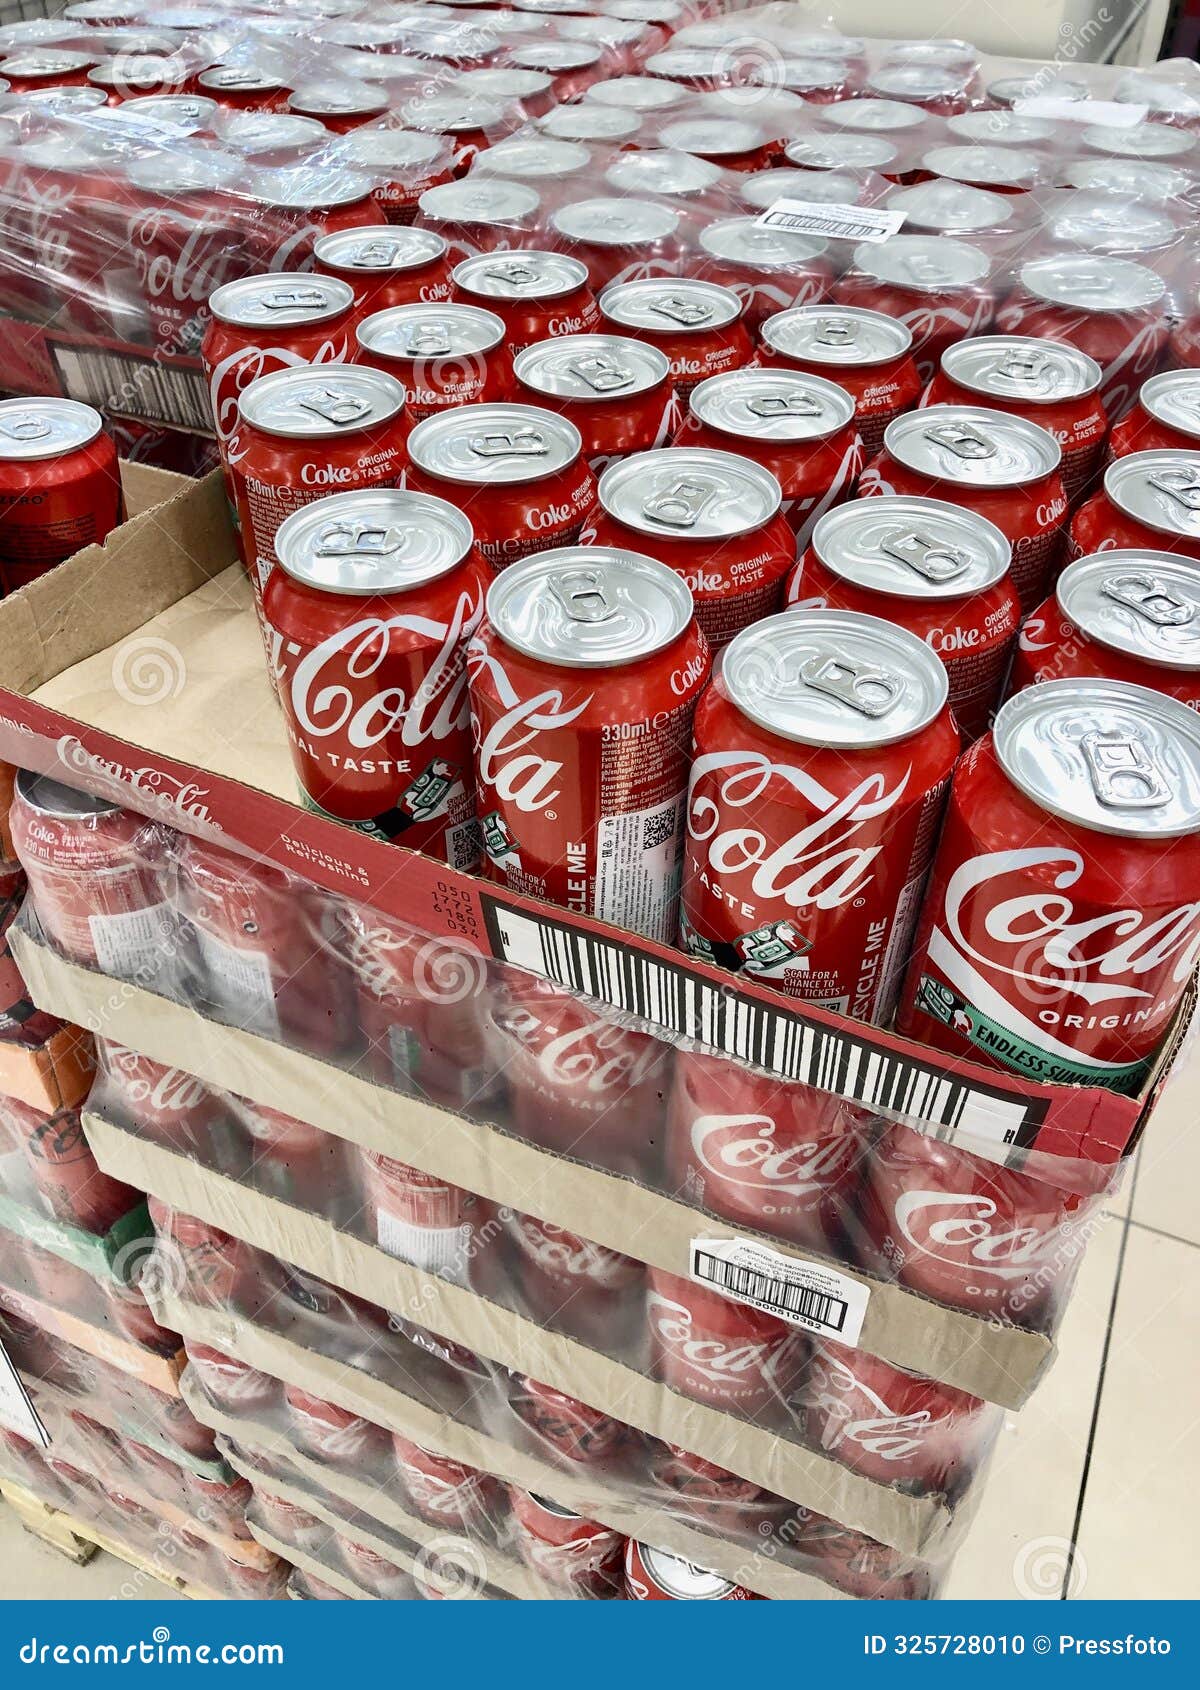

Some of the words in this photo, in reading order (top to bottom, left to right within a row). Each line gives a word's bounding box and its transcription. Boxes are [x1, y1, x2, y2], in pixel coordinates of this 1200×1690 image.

[372, 186, 399, 201] oke
[419, 282, 449, 304] Coke
[548, 315, 583, 337] Coke
[668, 356, 702, 375] oke
[705, 345, 738, 362] ORIGINAL
[707, 357, 732, 371] TASTE
[403, 384, 438, 405] oke
[443, 379, 485, 394] ORIGINAL
[446, 390, 475, 404] TASTE
[863, 382, 900, 399] ORIGINAL
[864, 394, 893, 408] TASTE
[1074, 425, 1097, 441] TASTE
[301, 463, 352, 486] Coke
[357, 447, 400, 469] ORIGINAL
[359, 462, 393, 480] TASTE
[525, 503, 572, 531] Coke
[571, 475, 594, 502] ORIGINAL
[575, 490, 595, 513] TASTE
[1036, 500, 1065, 527] Coke
[729, 551, 773, 576] ORIGINAL
[731, 567, 765, 587] TASTE
[926, 626, 981, 653] Coke
[984, 598, 1014, 628] ORIGINAL
[986, 615, 1013, 639] TASTE
[670, 654, 705, 697] Coke
[467, 640, 596, 813] la
[600, 716, 650, 743] 330ml
[326, 752, 412, 774] TASTE
[28, 819, 56, 845] Coke
[686, 750, 913, 910] Cola
[280, 833, 352, 872] Delicious
[357, 866, 369, 878] &
[285, 843, 370, 887] Refreshing
[566, 842, 587, 874] ME
[437, 881, 471, 902] 050
[524, 872, 539, 884] FOR
[540, 879, 547, 887] A
[535, 885, 545, 895] TO
[691, 857, 756, 920] TASTE
[431, 891, 474, 915] 1772
[567, 878, 587, 914] CLE
[433, 903, 477, 928] 6180
[447, 919, 479, 940] 034
[865, 916, 888, 953] ME
[783, 967, 810, 979] SCAN
[812, 971, 830, 980] FOR
[832, 970, 839, 979] A
[783, 977, 820, 989] CHANCE
[823, 979, 835, 988] TO
[782, 986, 802, 997] WIN
[803, 986, 840, 998] TICKETS
[851, 953, 880, 1022] CYCLE
[1038, 994, 1177, 1030] ORIGINAL
[975, 1024, 1045, 1073] ENDLESS
[1003, 1129, 1016, 1144] H
[685, 1376, 766, 1397] ORIGINA
